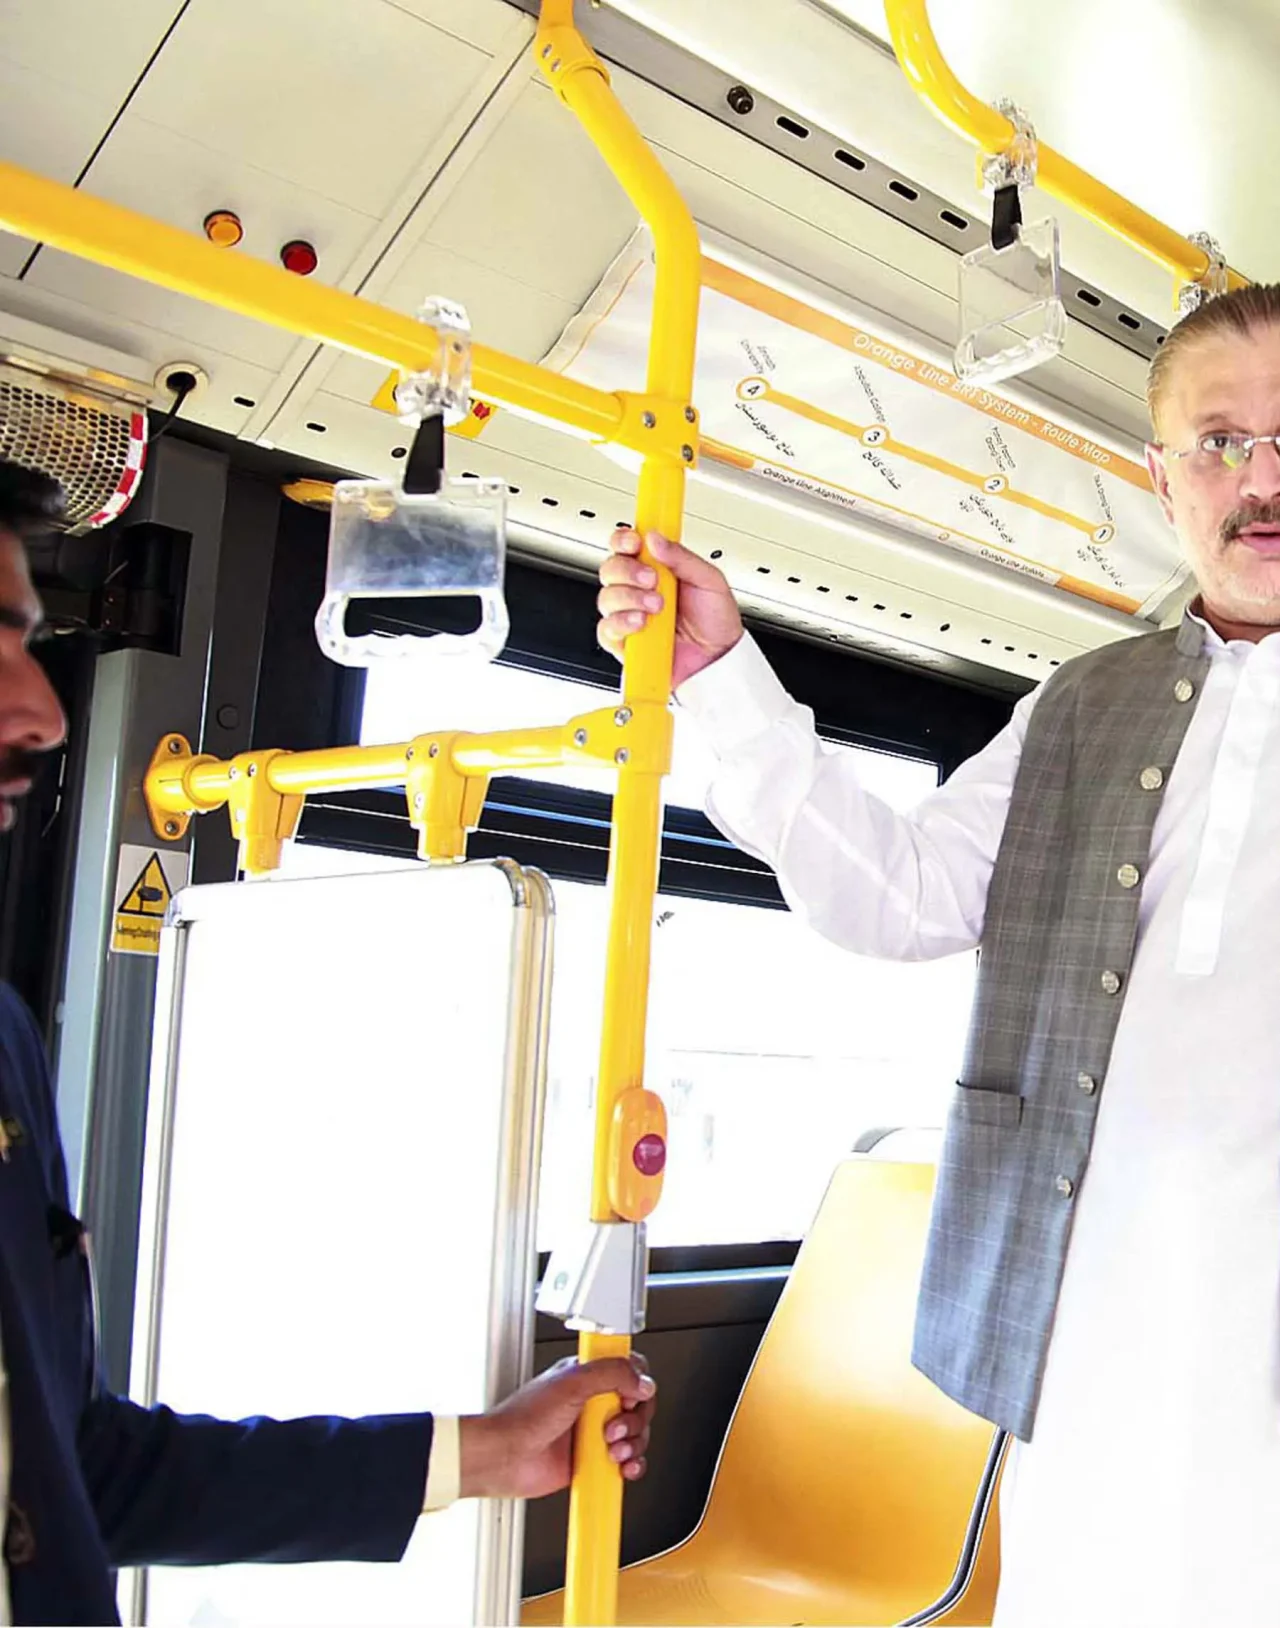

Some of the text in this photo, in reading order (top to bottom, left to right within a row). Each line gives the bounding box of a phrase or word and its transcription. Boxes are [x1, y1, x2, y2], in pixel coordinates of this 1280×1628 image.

[854, 333, 915, 369] Orange
[919, 363, 949, 386] Line
[952, 380, 982, 399] BRT
[980, 392, 1029, 423] System
[1041, 422, 1080, 449] Route
[1079, 441, 1111, 465] Map
[868, 431, 880, 442] 3
[763, 467, 856, 506] Orange Line Alignment
[988, 479, 1000, 490] 2
